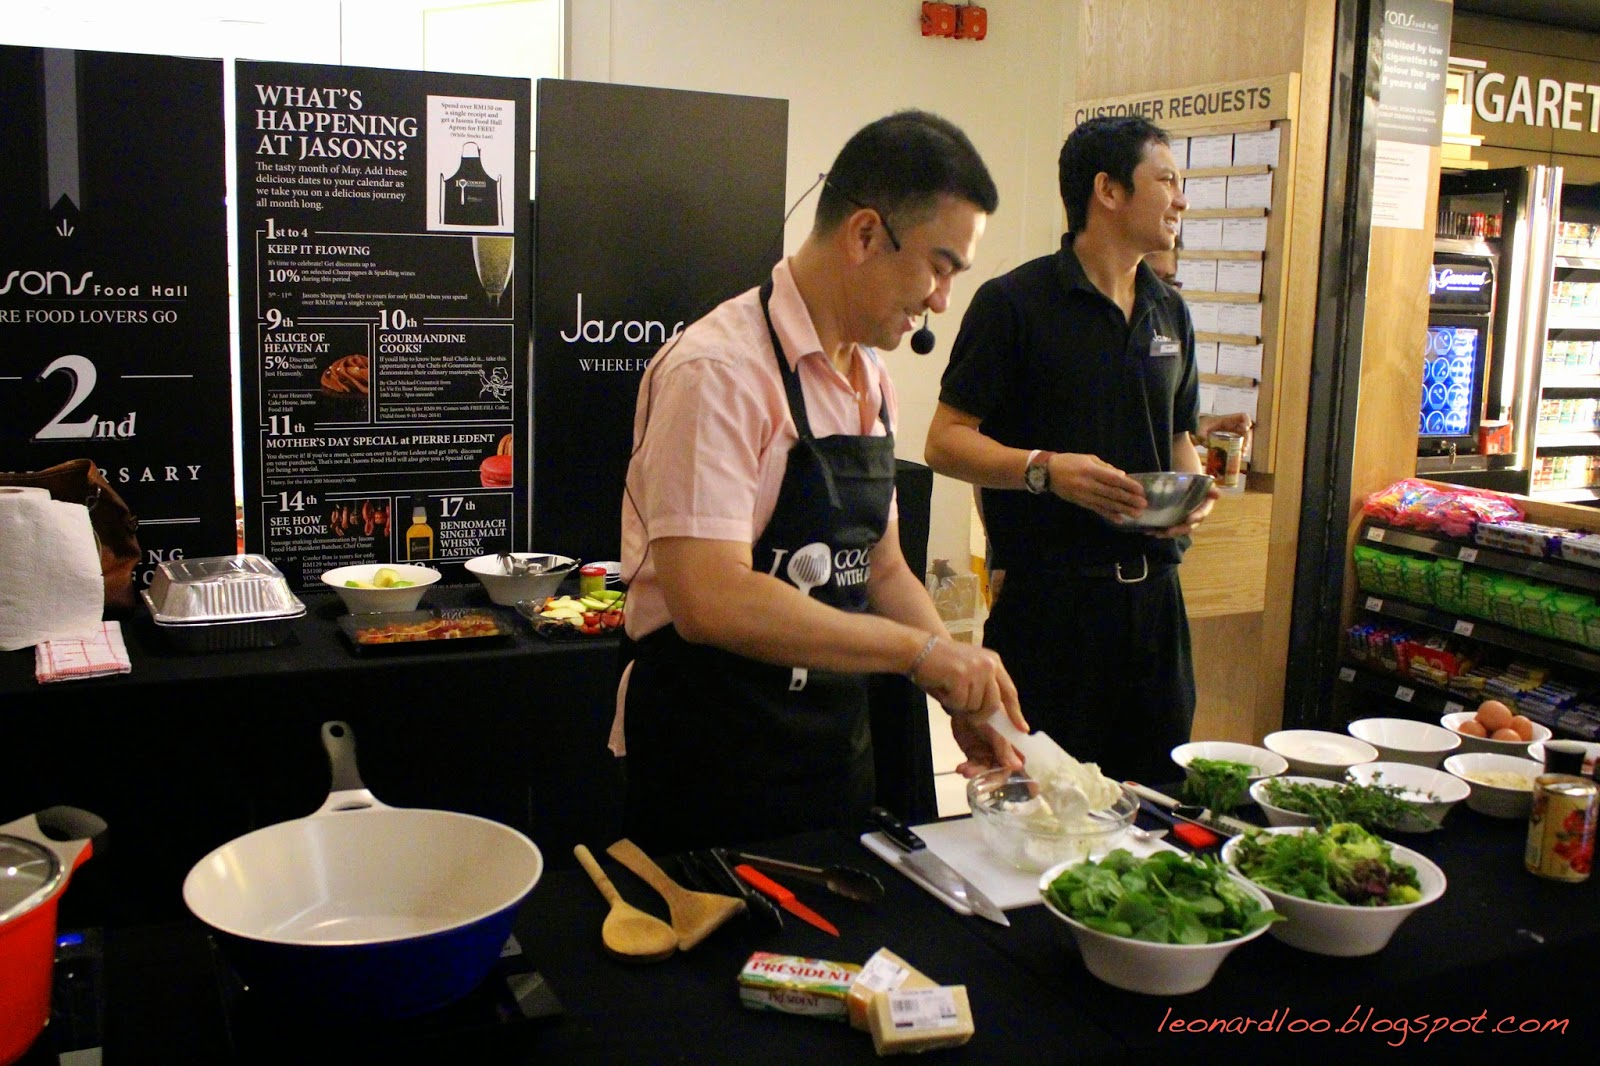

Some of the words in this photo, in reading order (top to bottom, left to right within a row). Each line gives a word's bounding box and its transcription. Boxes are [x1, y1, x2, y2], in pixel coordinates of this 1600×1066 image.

[1417, 44, 1426, 54] by
[1429, 45, 1444, 55] law
[1386, 53, 1427, 66] cigarettes
[1430, 58, 1438, 67] to
[1384, 64, 1408, 75] below
[1410, 68, 1424, 77] the
[1426, 72, 1440, 82] age
[1414, 82, 1426, 90] old
[1169, 86, 1272, 118] REQUESTS
[256, 109, 418, 137] HAPPENING
[256, 135, 292, 155] AT
[299, 137, 407, 160] JASONS?
[256, 162, 272, 171] The
[275, 163, 296, 174] tasty
[298, 164, 328, 174] month
[330, 164, 340, 174] of
[342, 165, 362, 177] May.
[365, 166, 383, 175] Add
[385, 167, 407, 176] these
[256, 174, 295, 184] delicious
[298, 175, 321, 185] dates
[323, 177, 331, 185] to
[334, 179, 355, 188] your
[356, 177, 393, 188] calendar
[256, 188, 269, 196] we
[271, 186, 290, 197] take
[292, 189, 308, 199] you
[332, 187, 370, 198] delicious
[372, 189, 406, 201] journey
[256, 198, 267, 208] all
[269, 199, 299, 208] month
[302, 199, 324, 212] long.
[288, 229, 299, 237] to
[301, 228, 308, 237] 4
[268, 244, 297, 254] KEEP
[300, 245, 313, 254] IT
[315, 246, 370, 255] FLOWING
[269, 269, 300, 282] 10%
[94, 284, 140, 296] Food
[152, 284, 188, 296] Hall
[26, 310, 75, 324] FOOD
[80, 310, 148, 324] LOVERS
[152, 310, 178, 324] GO
[266, 308, 294, 330] 9th
[379, 309, 417, 330] 10th
[560, 292, 684, 343] Jasons
[264, 334, 272, 342] A
[275, 333, 307, 342] SLICE
[310, 333, 325, 342] OF
[380, 334, 466, 343] GOURMANDINE
[264, 344, 312, 353] HEAVEN
[315, 344, 330, 353] AT
[380, 344, 422, 353] COOKS!
[265, 356, 289, 369] 5%
[578, 358, 633, 371] WHERE
[34, 354, 137, 441] 2nd
[328, 437, 351, 447] DAY
[353, 436, 398, 446] SPECIAL
[412, 435, 451, 445] PIERRE
[453, 434, 495, 443] LEDENT
[270, 517, 290, 526] SEE
[292, 515, 321, 525] HOW
[440, 519, 506, 530] BENROMACH
[294, 525, 328, 535] DONE
[440, 529, 476, 539] SINGLE
[479, 528, 506, 537] MALT
[440, 538, 482, 548] WHISKY
[440, 547, 484, 557] TASTING
[772, 548, 788, 577] I
[835, 570, 864, 587] WITH
